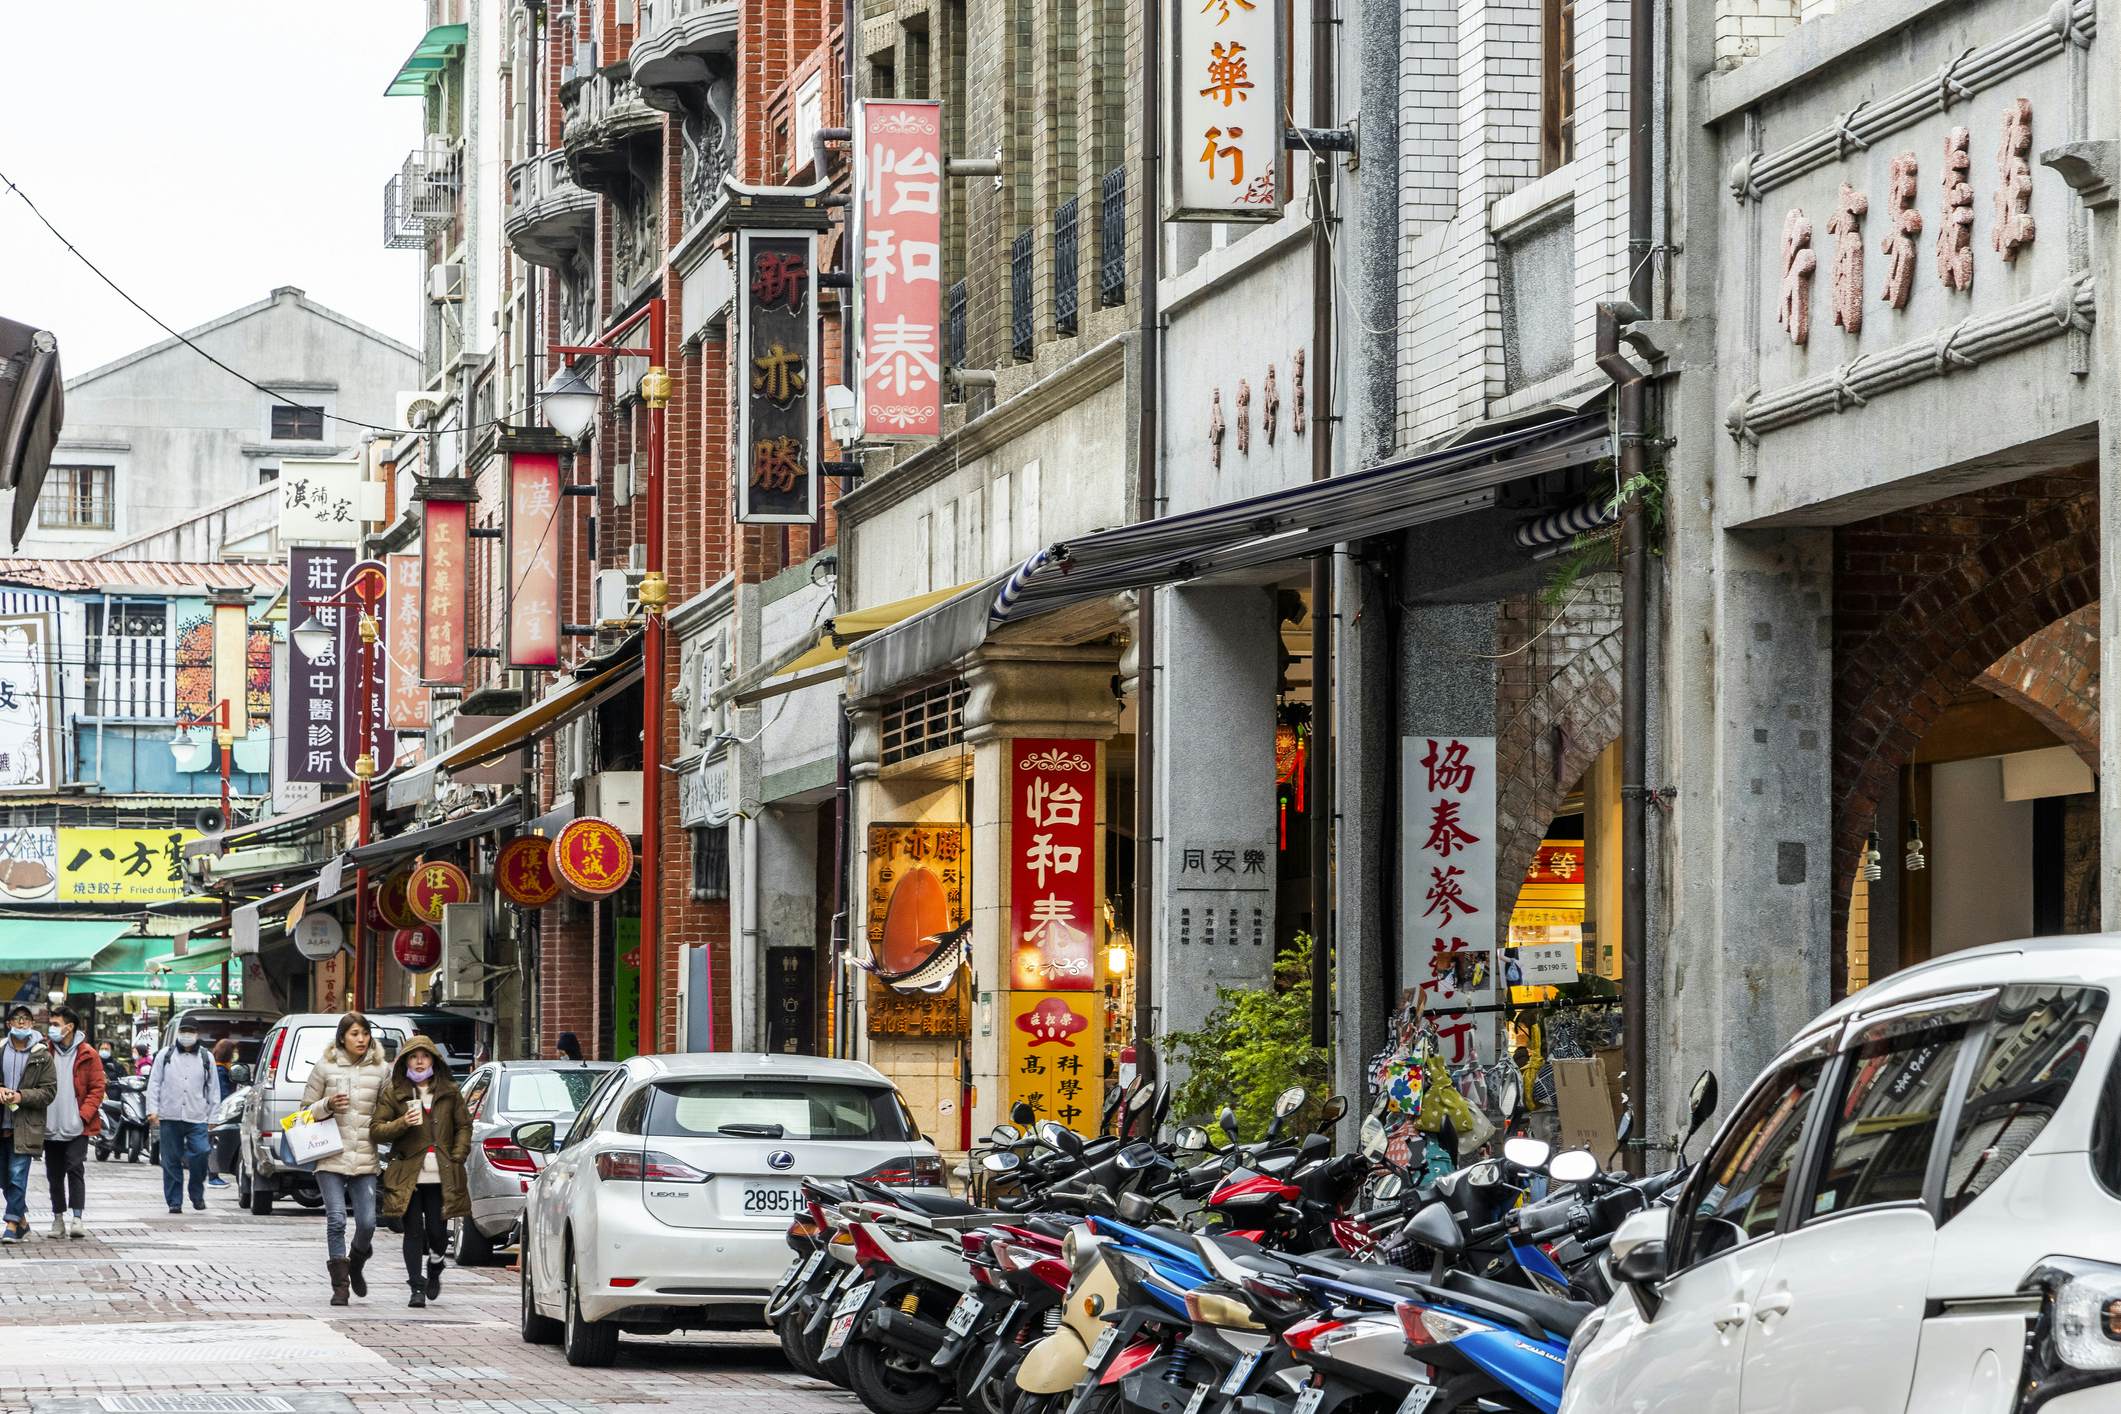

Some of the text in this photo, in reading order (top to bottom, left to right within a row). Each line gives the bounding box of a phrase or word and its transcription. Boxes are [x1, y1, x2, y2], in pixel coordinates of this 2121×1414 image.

[865, 142, 940, 397] 怡和泰
[750, 251, 808, 493] 新亦勝
[581, 831, 608, 879] 漢誠
[1024, 775, 1087, 949] 怡和泰
[1181, 848, 1266, 874] 同安樂
[130, 885, 154, 894] Fried
[425, 867, 450, 918] 旺泰
[1056, 1054, 1084, 1132] 科學中
[650, 1190, 689, 1199] LEXUS
[744, 1189, 810, 1211] 2895-H
